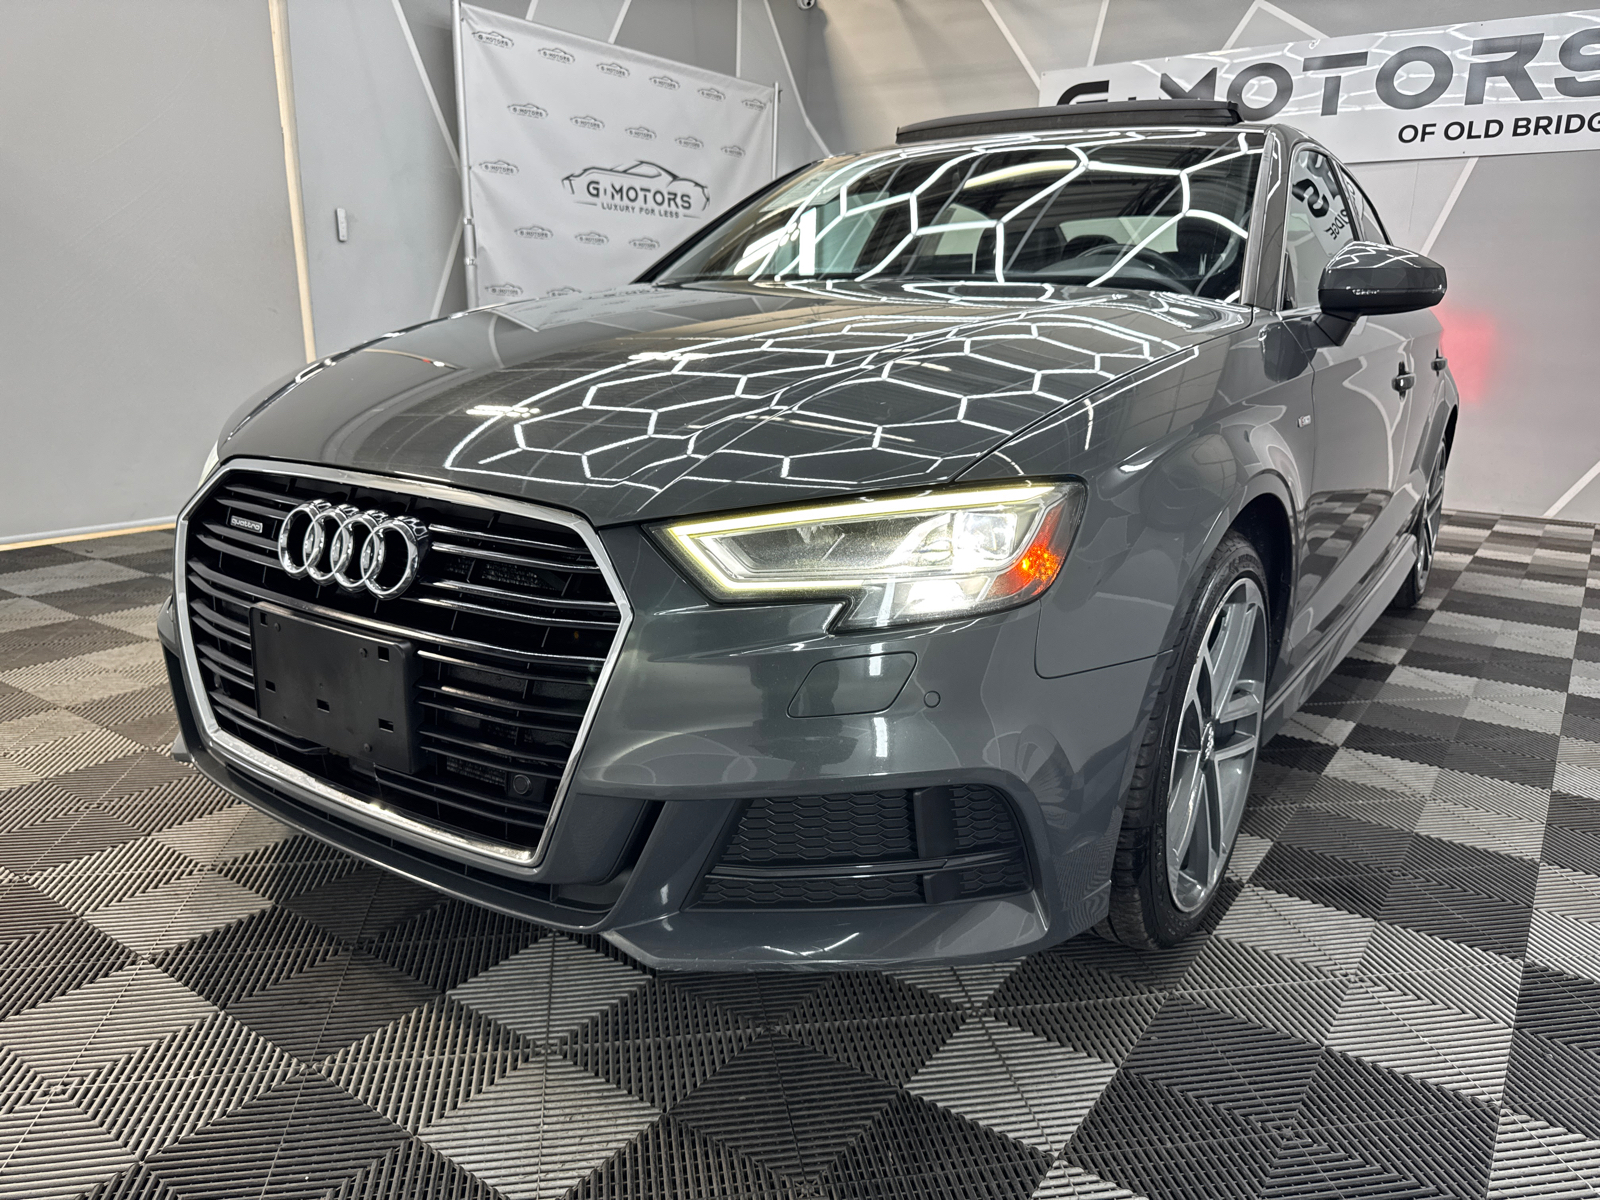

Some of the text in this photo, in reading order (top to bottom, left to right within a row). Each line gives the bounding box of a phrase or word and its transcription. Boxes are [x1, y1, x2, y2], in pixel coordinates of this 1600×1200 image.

[1398, 123, 1437, 144] OF
[1444, 119, 1504, 141] OLD
[611, 183, 692, 210] MOTORS
[601, 202, 680, 219] LUXURY FOR LESS
[231, 518, 260, 531] quattro
